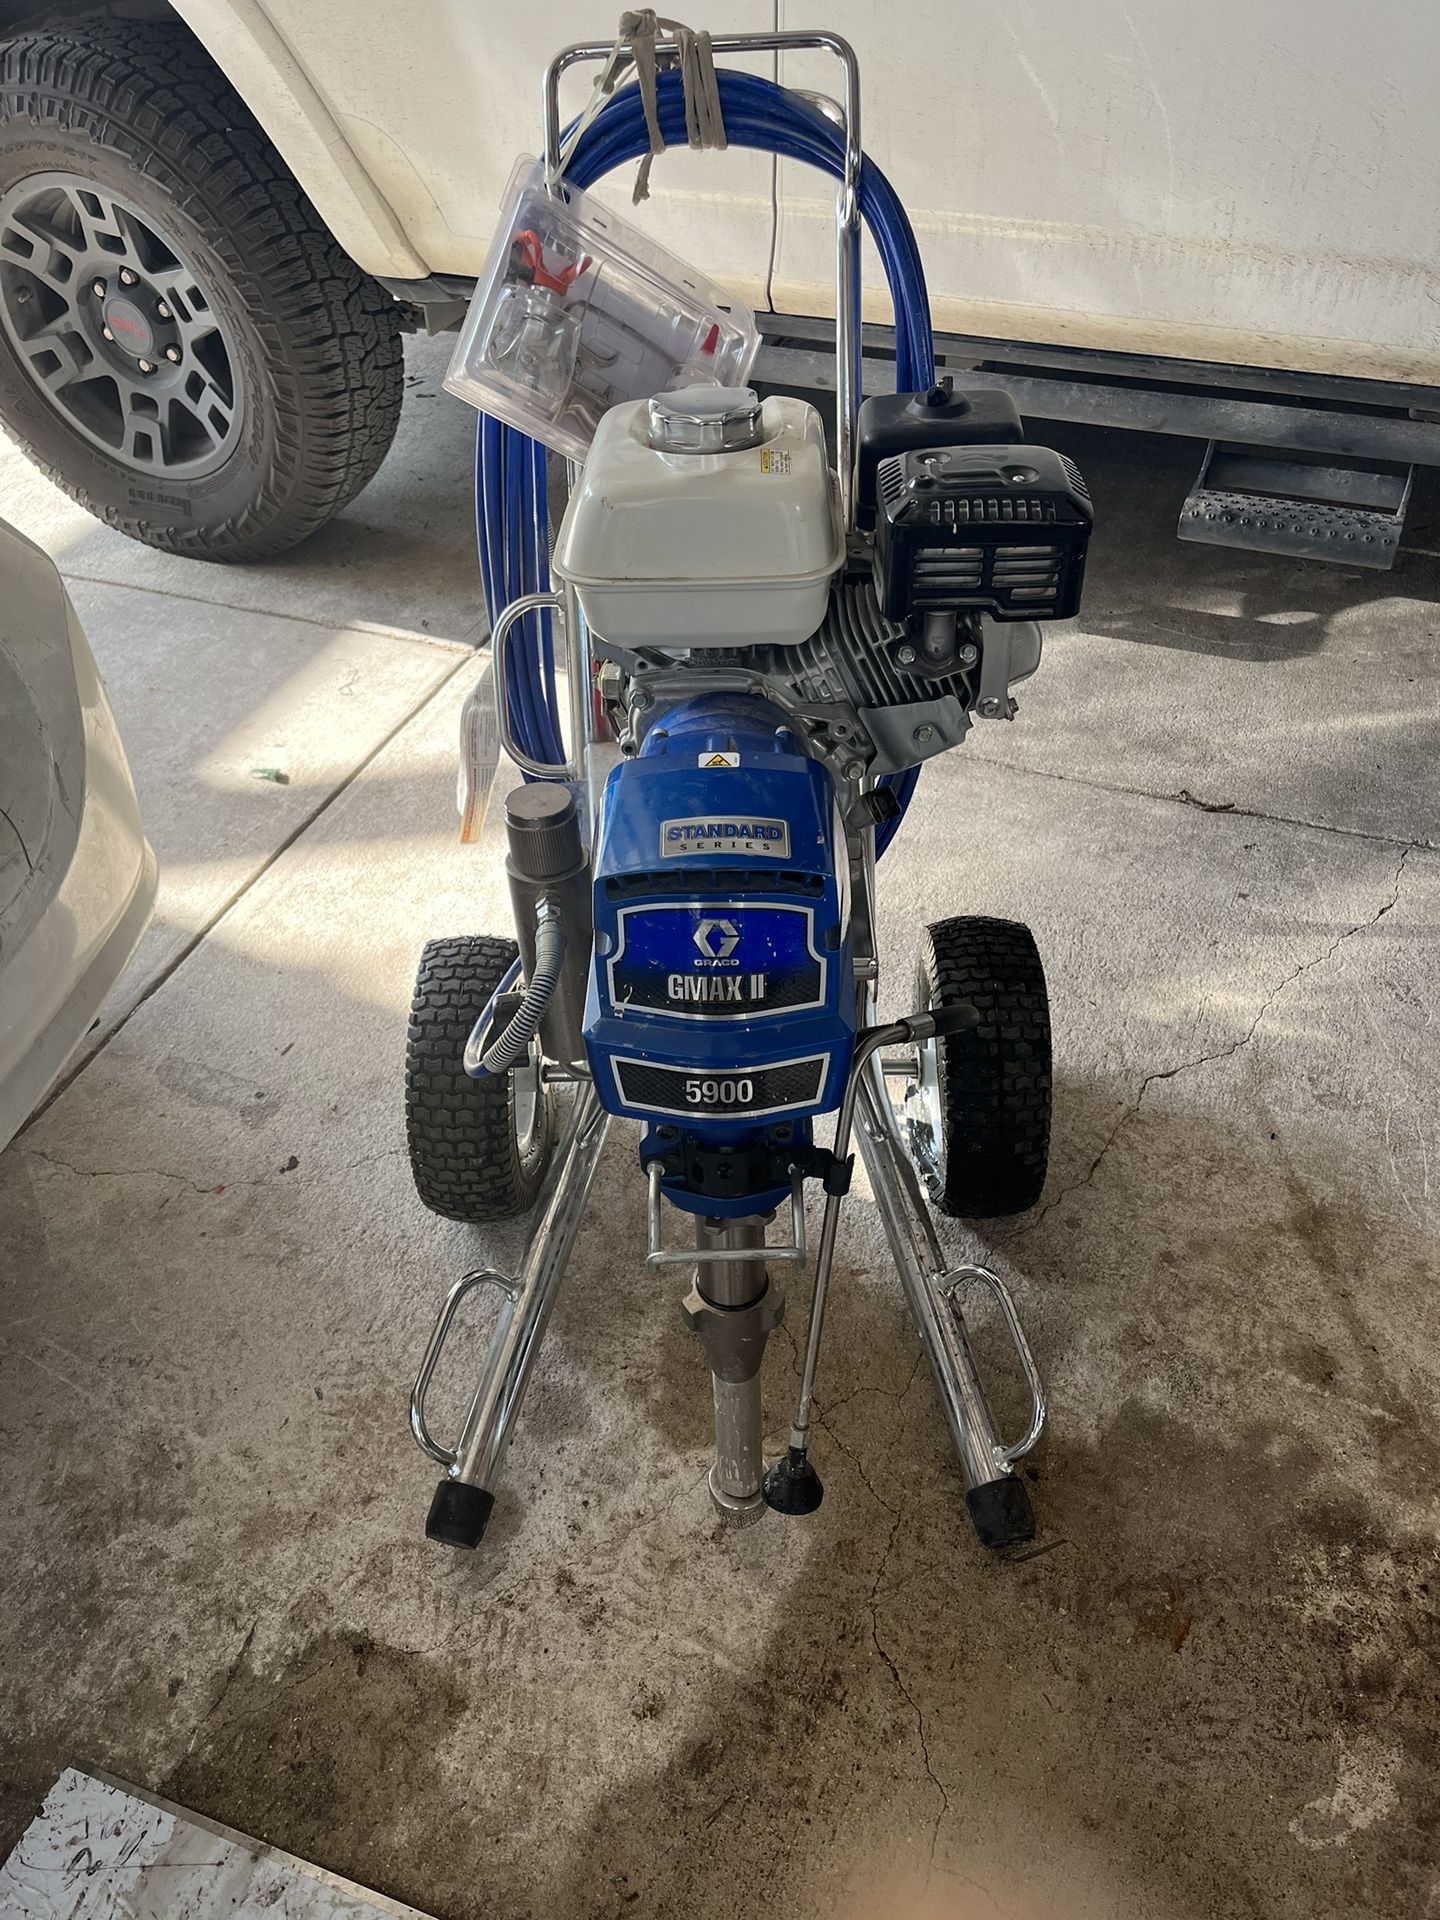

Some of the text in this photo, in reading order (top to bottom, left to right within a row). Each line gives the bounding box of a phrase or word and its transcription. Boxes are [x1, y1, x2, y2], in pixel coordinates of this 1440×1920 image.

[667, 823, 783, 841] STANDARD
[680, 842, 770, 850] SERIES
[694, 959, 740, 967] GRACO
[667, 973, 765, 1001] GMAX II
[685, 1079, 753, 1104] 5900
